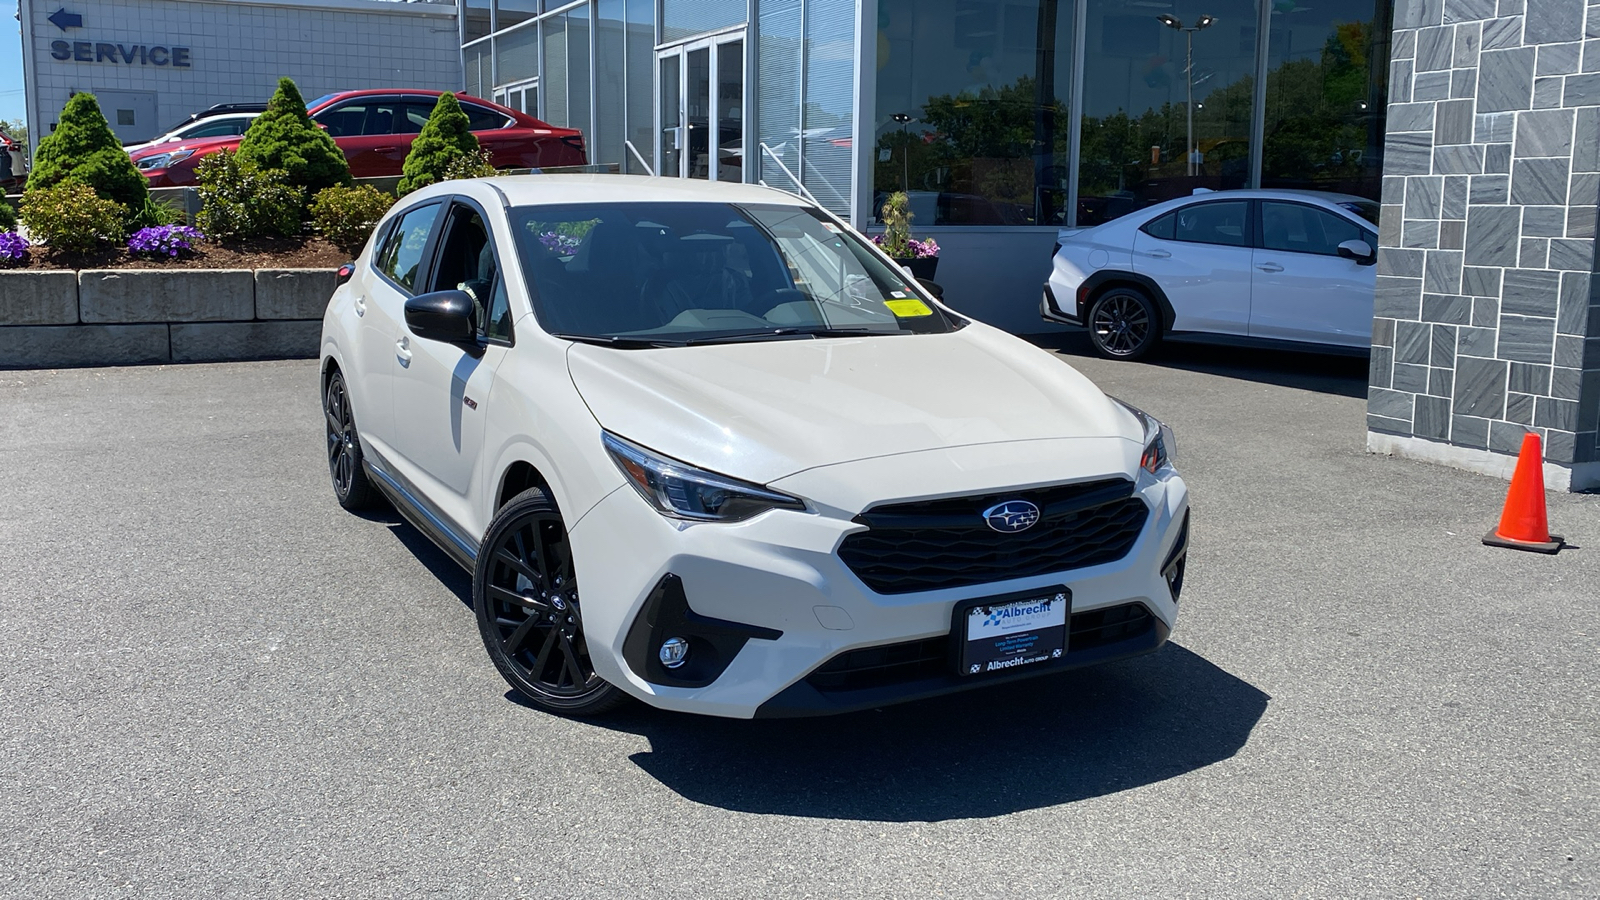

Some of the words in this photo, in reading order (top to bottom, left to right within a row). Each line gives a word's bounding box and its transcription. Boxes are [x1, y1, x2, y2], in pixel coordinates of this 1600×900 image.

[51, 40, 190, 67] SERVICE
[1002, 602, 1051, 618] Albrecht
[1002, 617, 1022, 625] AUTO
[1025, 612, 1051, 621] GROUP
[987, 656, 1024, 671] Albrecht
